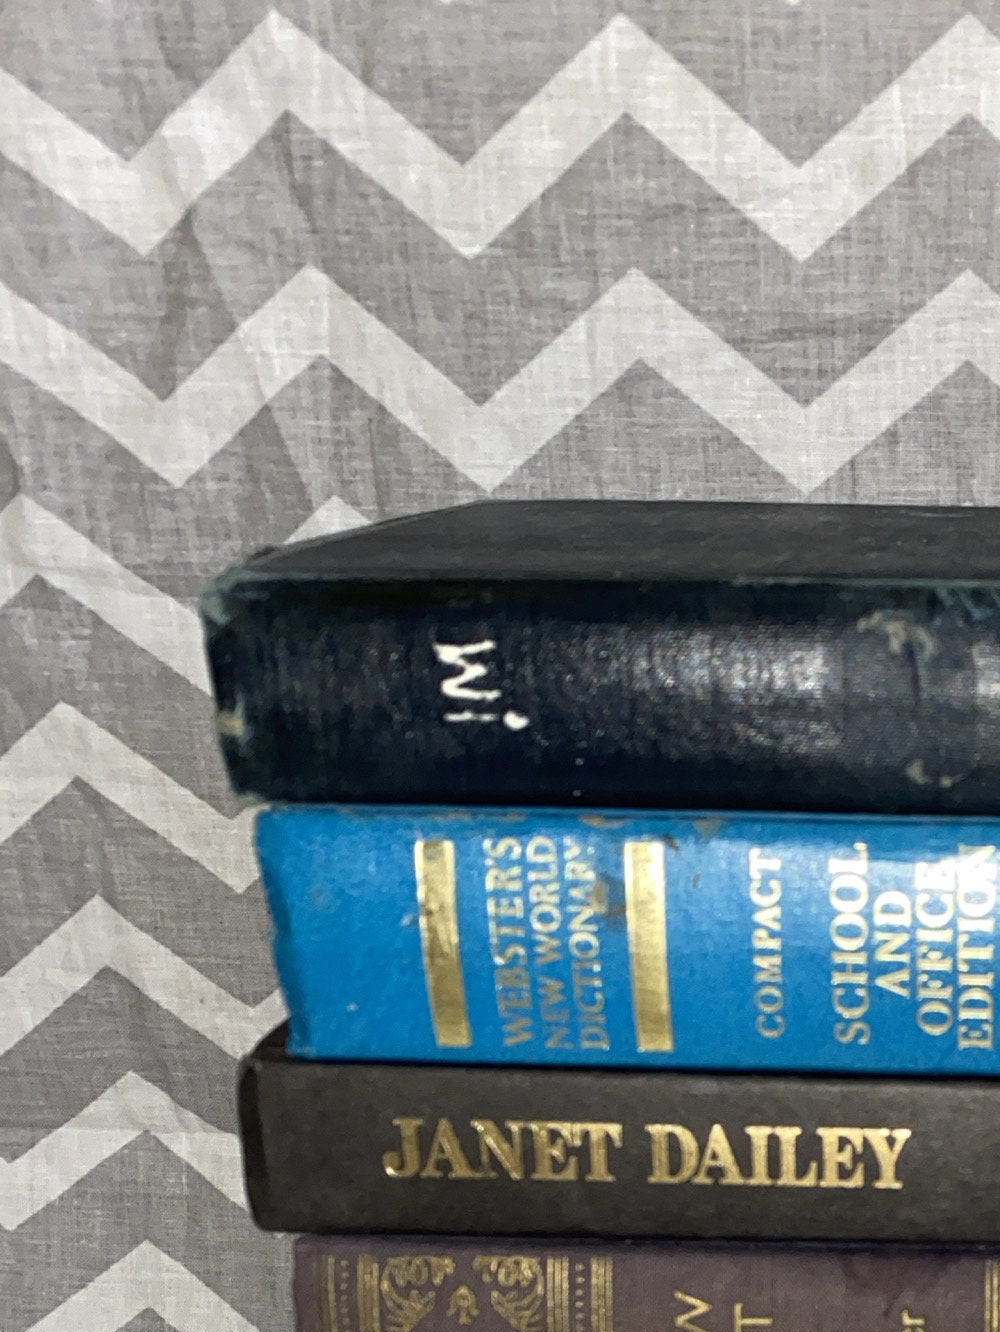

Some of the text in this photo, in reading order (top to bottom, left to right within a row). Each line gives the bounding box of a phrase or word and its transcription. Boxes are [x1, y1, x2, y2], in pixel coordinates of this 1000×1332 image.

[483, 836, 535, 1047] WEBSTER'S
[525, 836, 574, 1050] NEW WORLD
[562, 836, 610, 1051] DICTIONARY
[748, 847, 785, 1040] COMPACT
[828, 841, 871, 1046] SCHOOL
[873, 889, 913, 1000] AND
[913, 858, 956, 1037] OFFICE
[956, 842, 997, 1051] EDITION
[382, 1116, 912, 1190] JANET DAILEY
